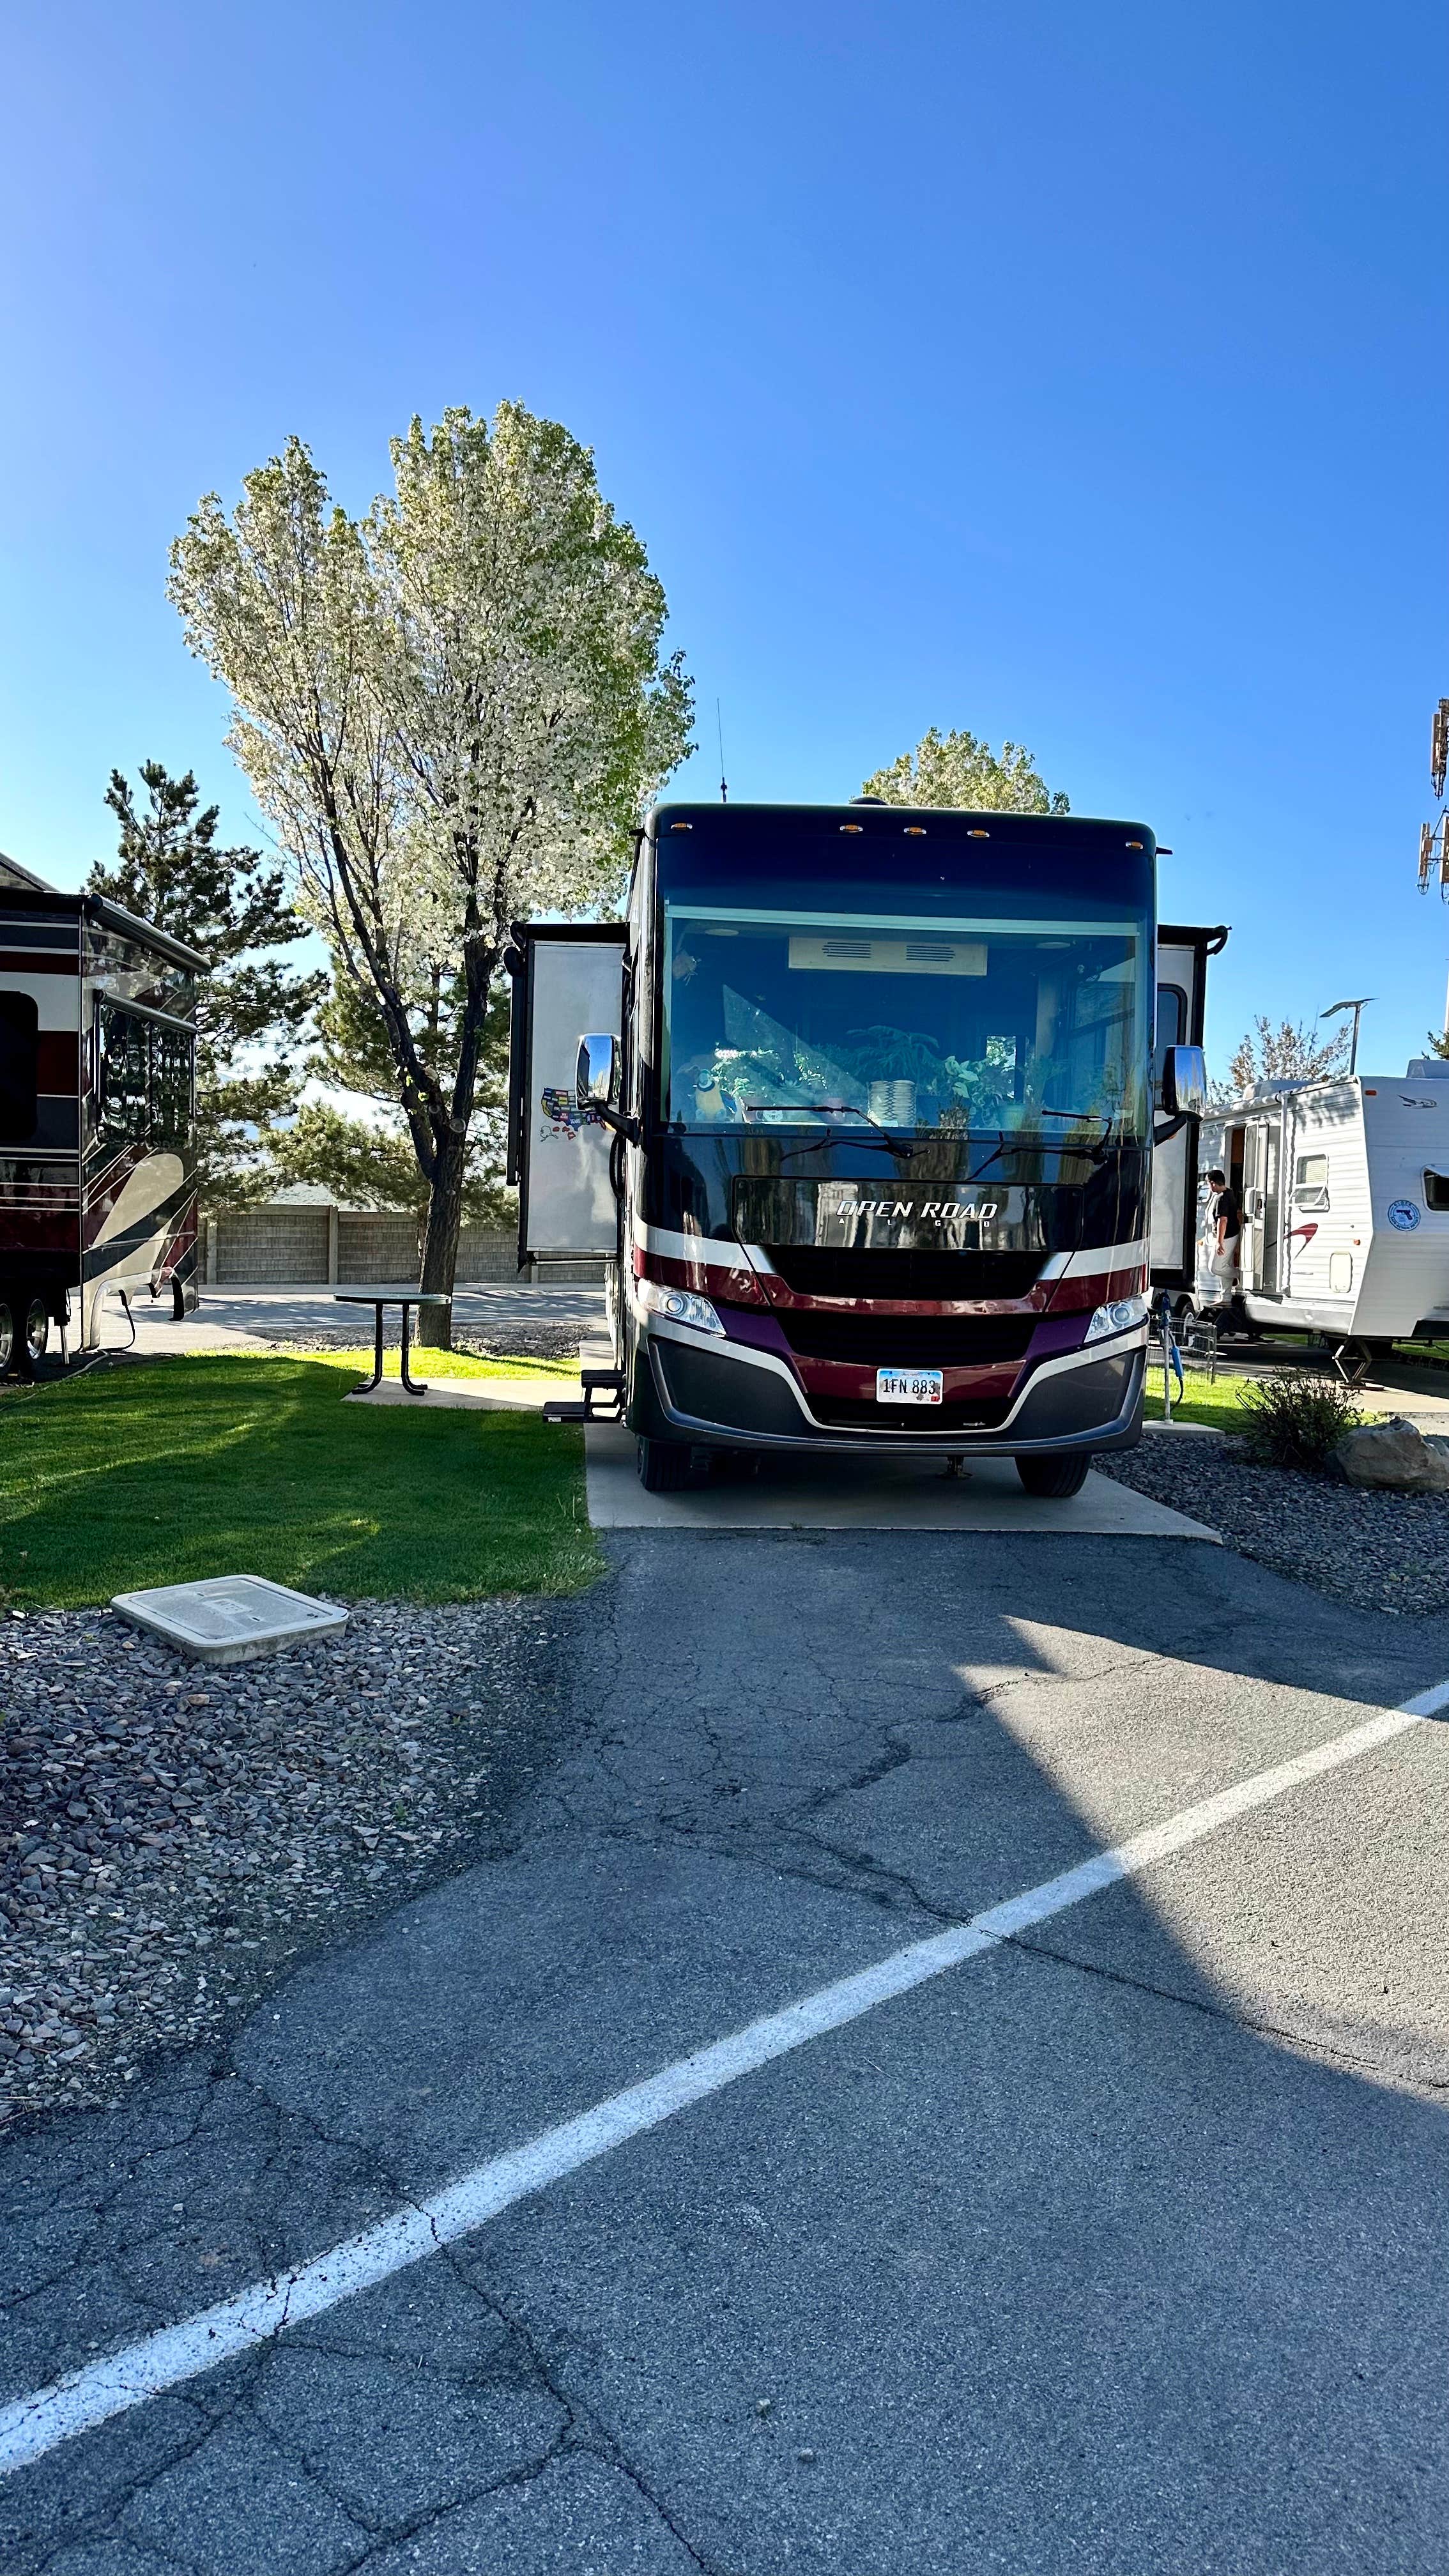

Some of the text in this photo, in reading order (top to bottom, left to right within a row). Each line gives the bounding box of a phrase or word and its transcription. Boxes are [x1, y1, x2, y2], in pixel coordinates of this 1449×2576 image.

[836, 1200, 998, 1219] OPEN ROAD
[883, 1378, 936, 1395] 1FN 883
